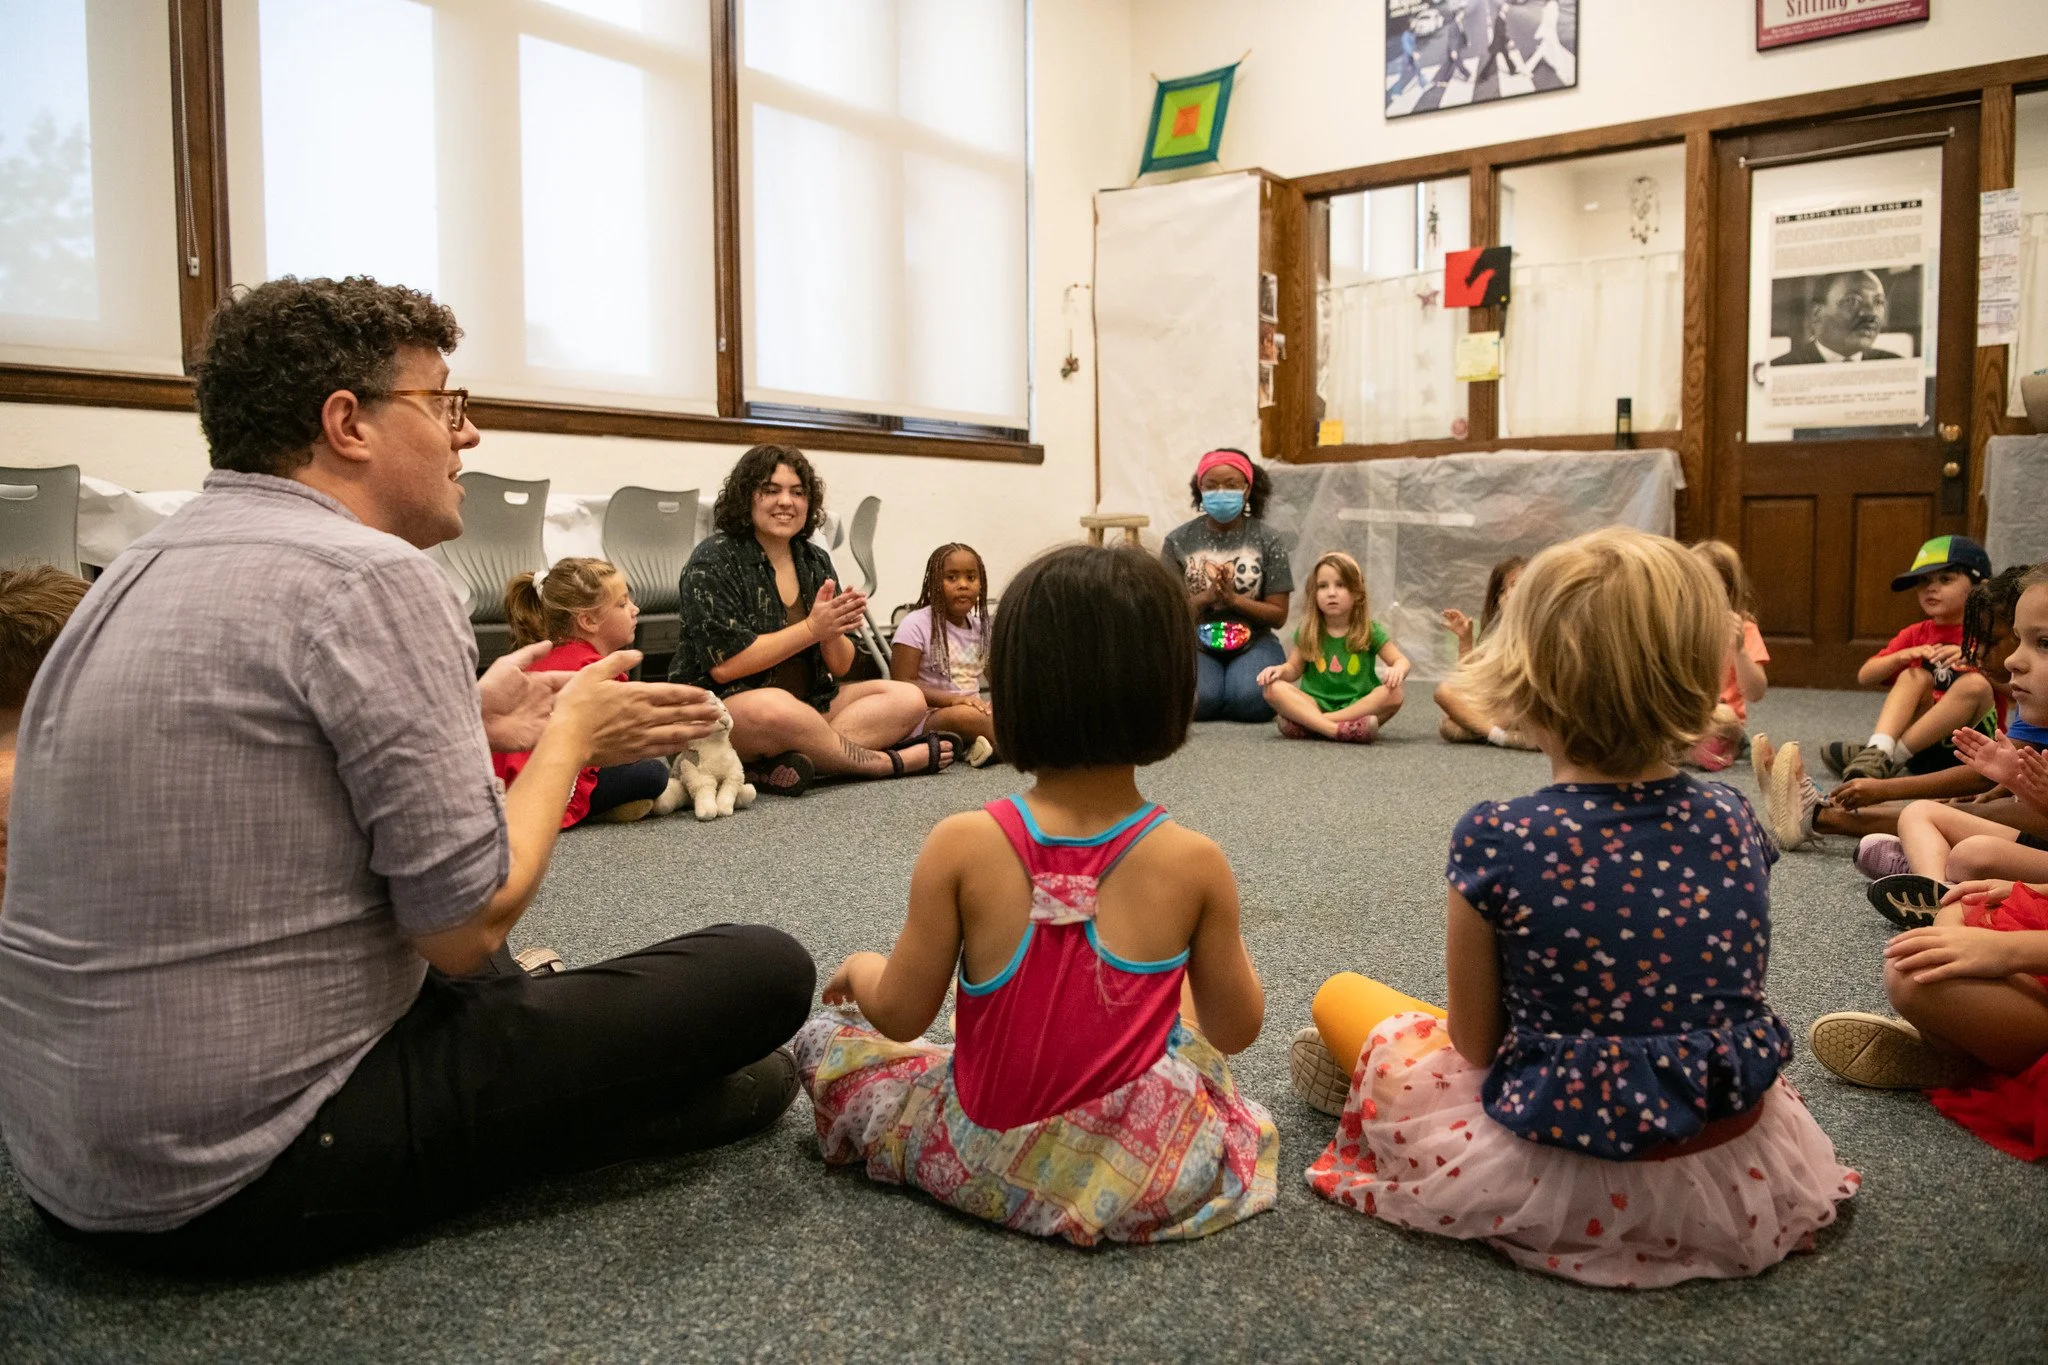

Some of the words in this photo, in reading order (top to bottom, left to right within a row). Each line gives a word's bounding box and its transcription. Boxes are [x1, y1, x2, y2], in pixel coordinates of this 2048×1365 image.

[1797, 210, 1832, 220] MARTIN
[1836, 205, 1873, 215] LUTHR
[1878, 202, 1902, 211] KING
